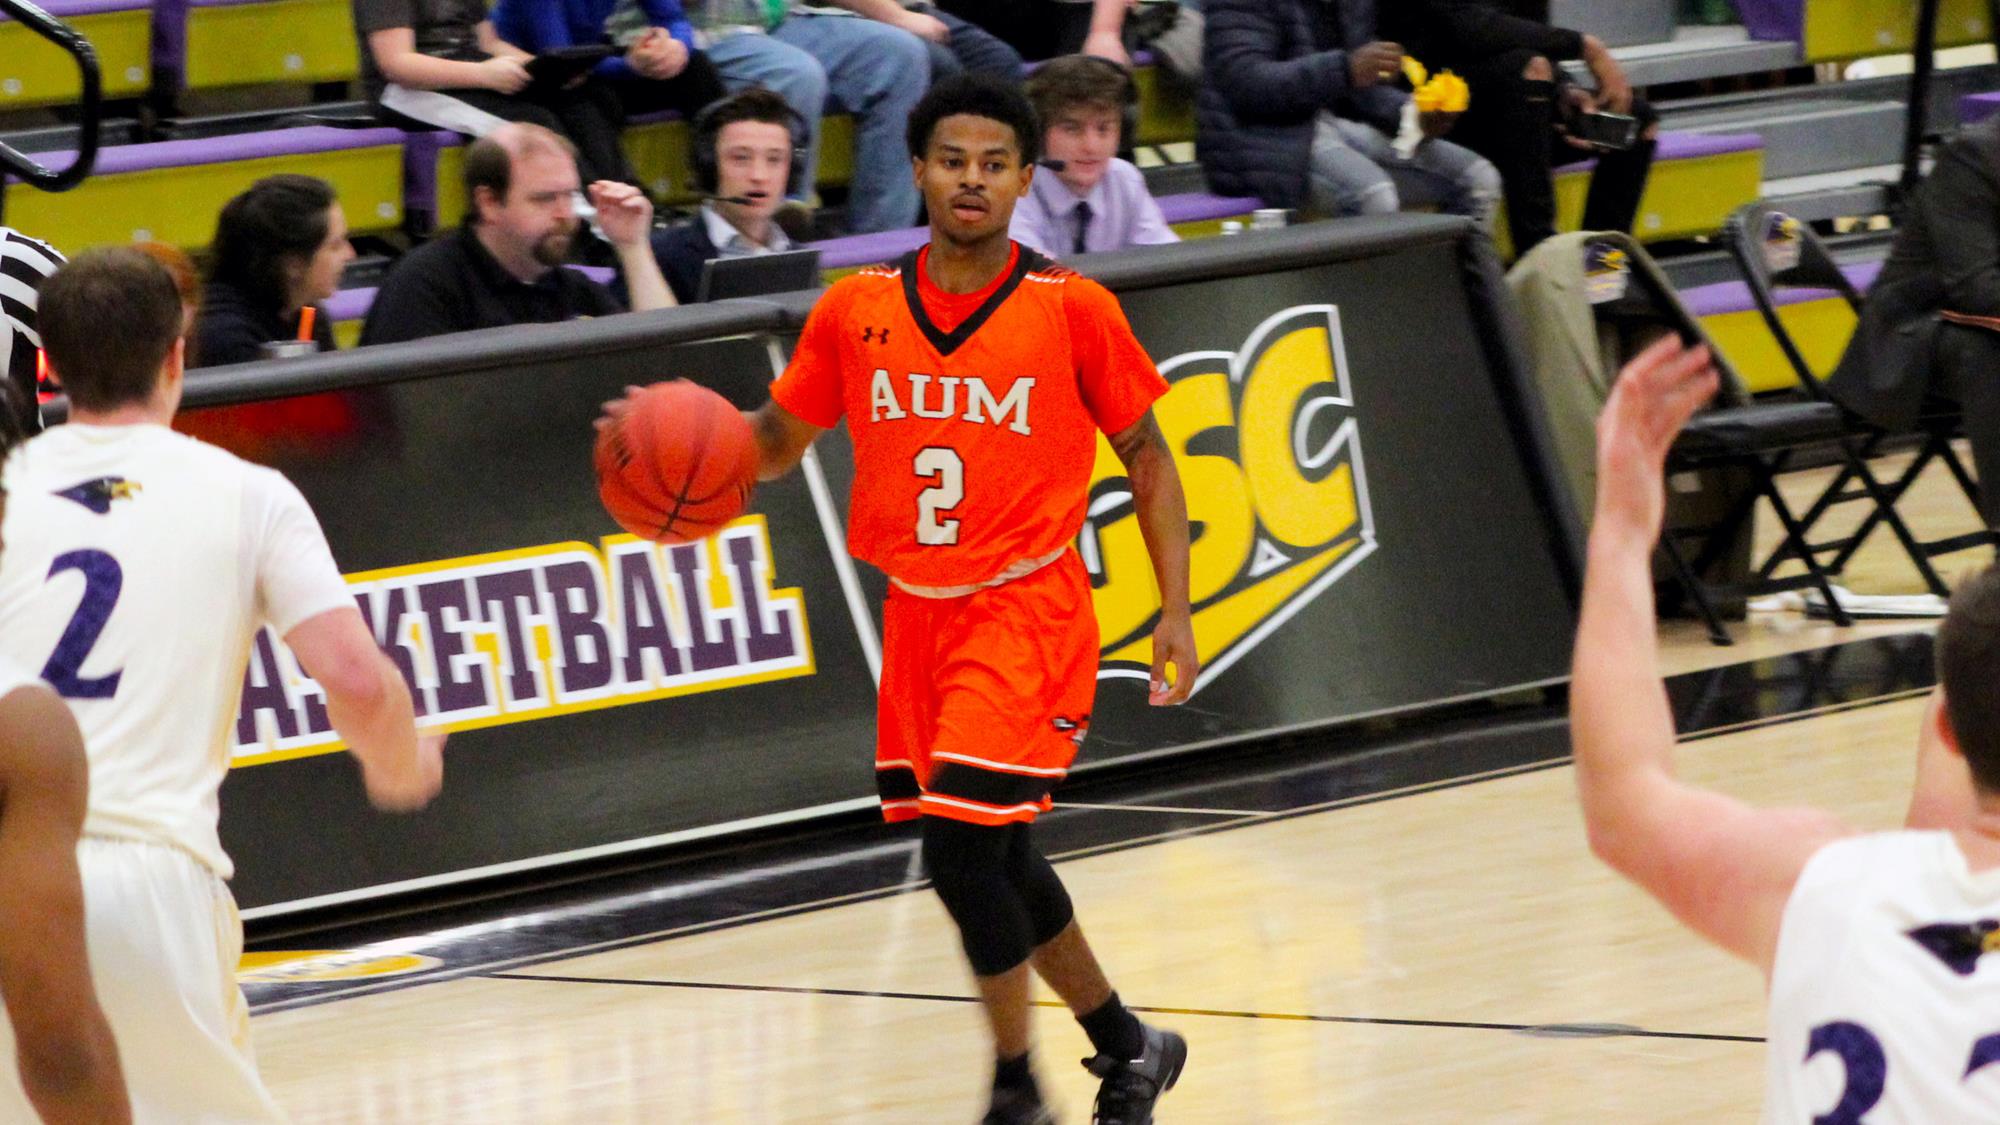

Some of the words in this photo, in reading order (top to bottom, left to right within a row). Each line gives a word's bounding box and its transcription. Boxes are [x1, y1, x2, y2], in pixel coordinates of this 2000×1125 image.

[870, 368, 1036, 436] AUM
[913, 445, 964, 546] 2
[40, 547, 124, 699] 2
[236, 533, 798, 745] AKETBALL
